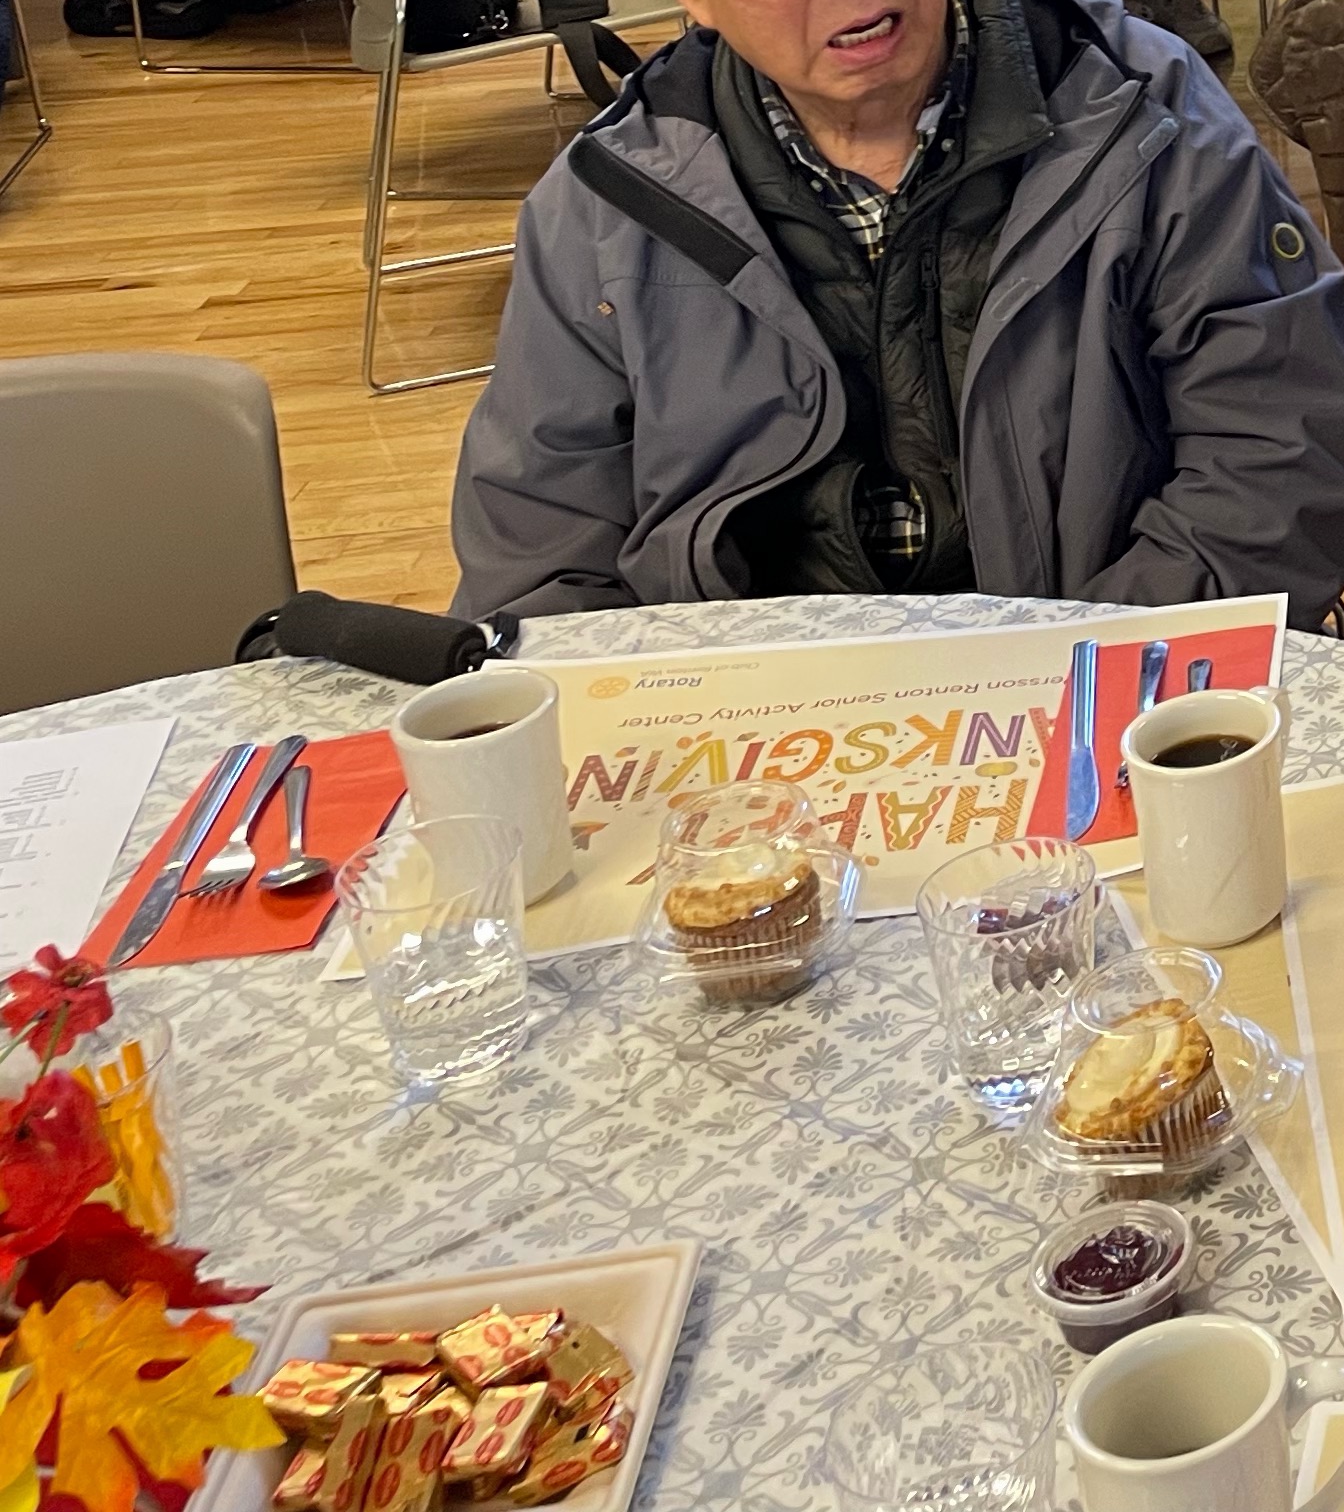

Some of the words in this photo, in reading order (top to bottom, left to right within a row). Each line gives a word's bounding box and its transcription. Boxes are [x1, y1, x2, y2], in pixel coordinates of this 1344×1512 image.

[633, 676, 703, 690] Rotary
[987, 674, 1066, 690] ersson
[895, 682, 980, 699] Renton
[810, 691, 888, 710] Senior
[709, 701, 805, 720] Activity
[617, 712, 703, 728] Center
